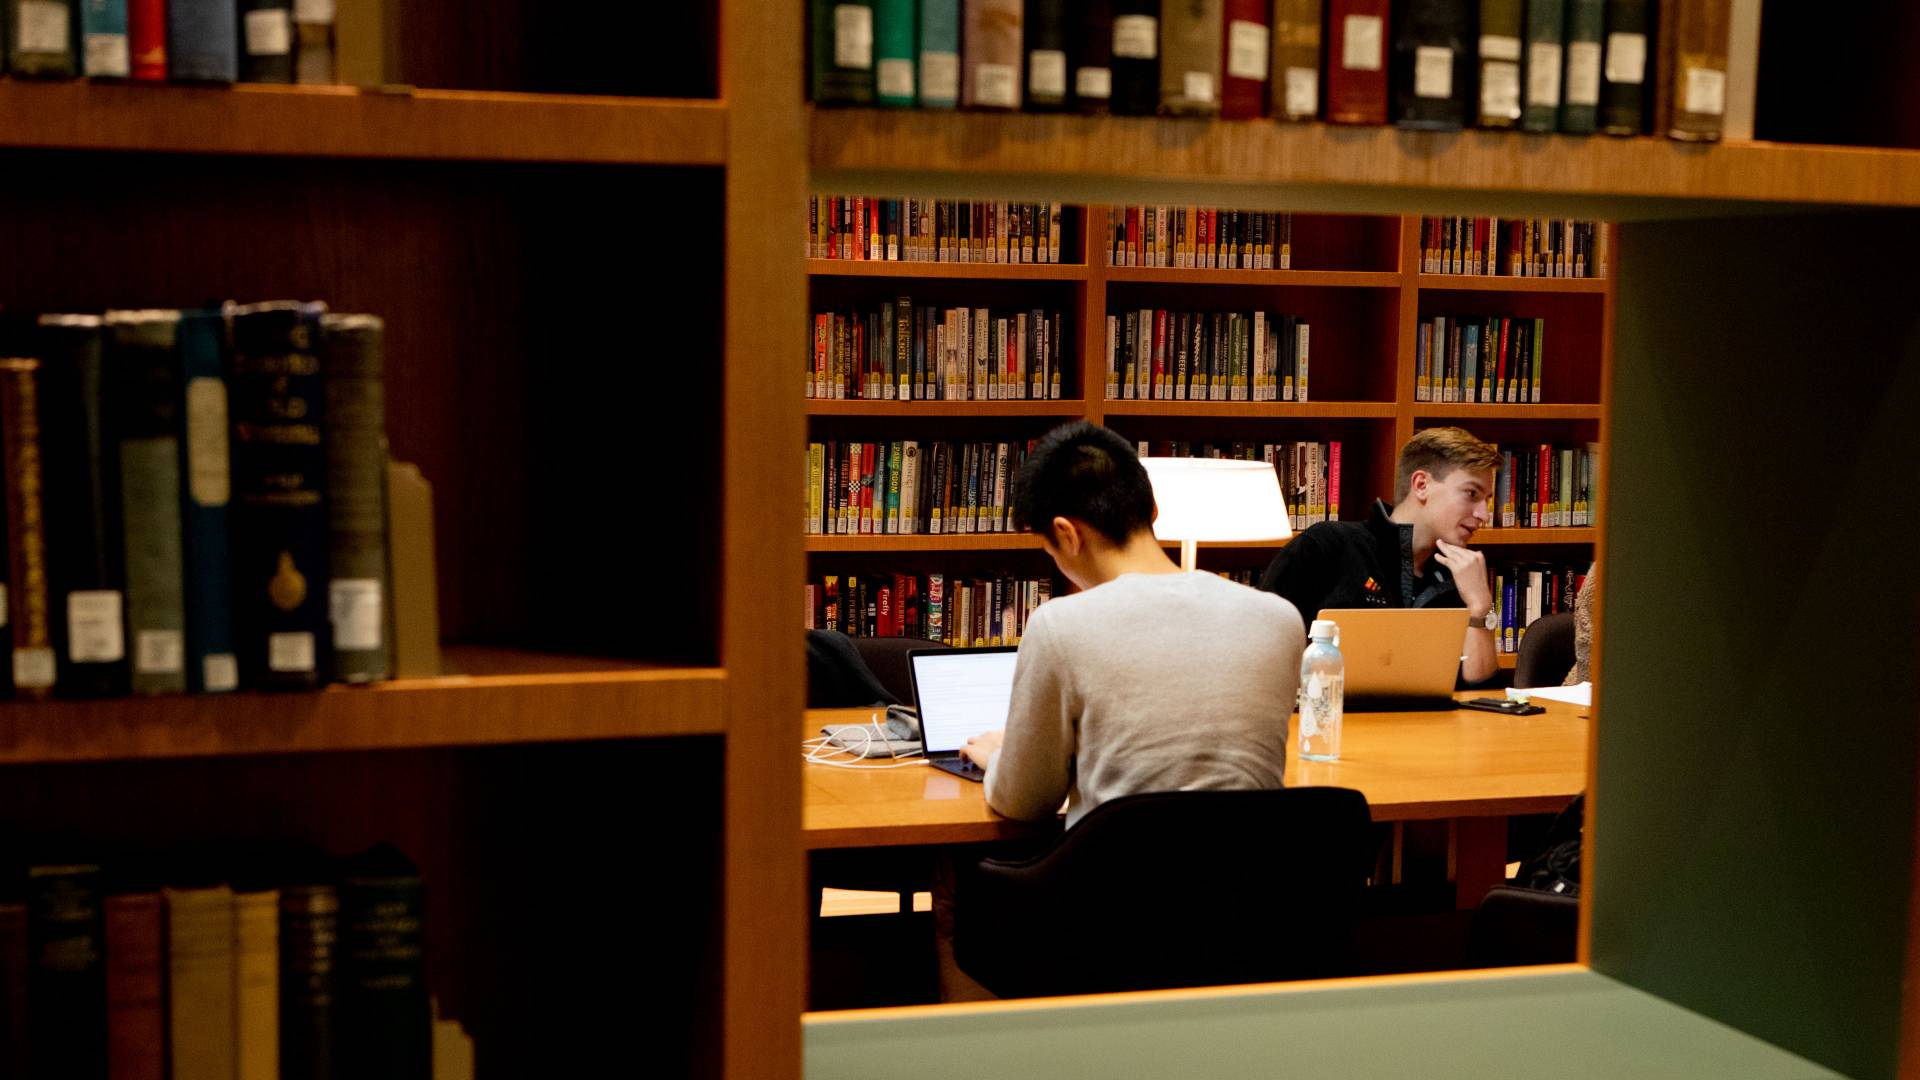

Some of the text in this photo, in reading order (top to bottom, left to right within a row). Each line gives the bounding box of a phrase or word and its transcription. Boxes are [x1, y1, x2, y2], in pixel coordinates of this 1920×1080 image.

[1178, 351, 1186, 376] FREEFA
[890, 471, 899, 493] ROOM
[880, 589, 890, 617] Firefly
